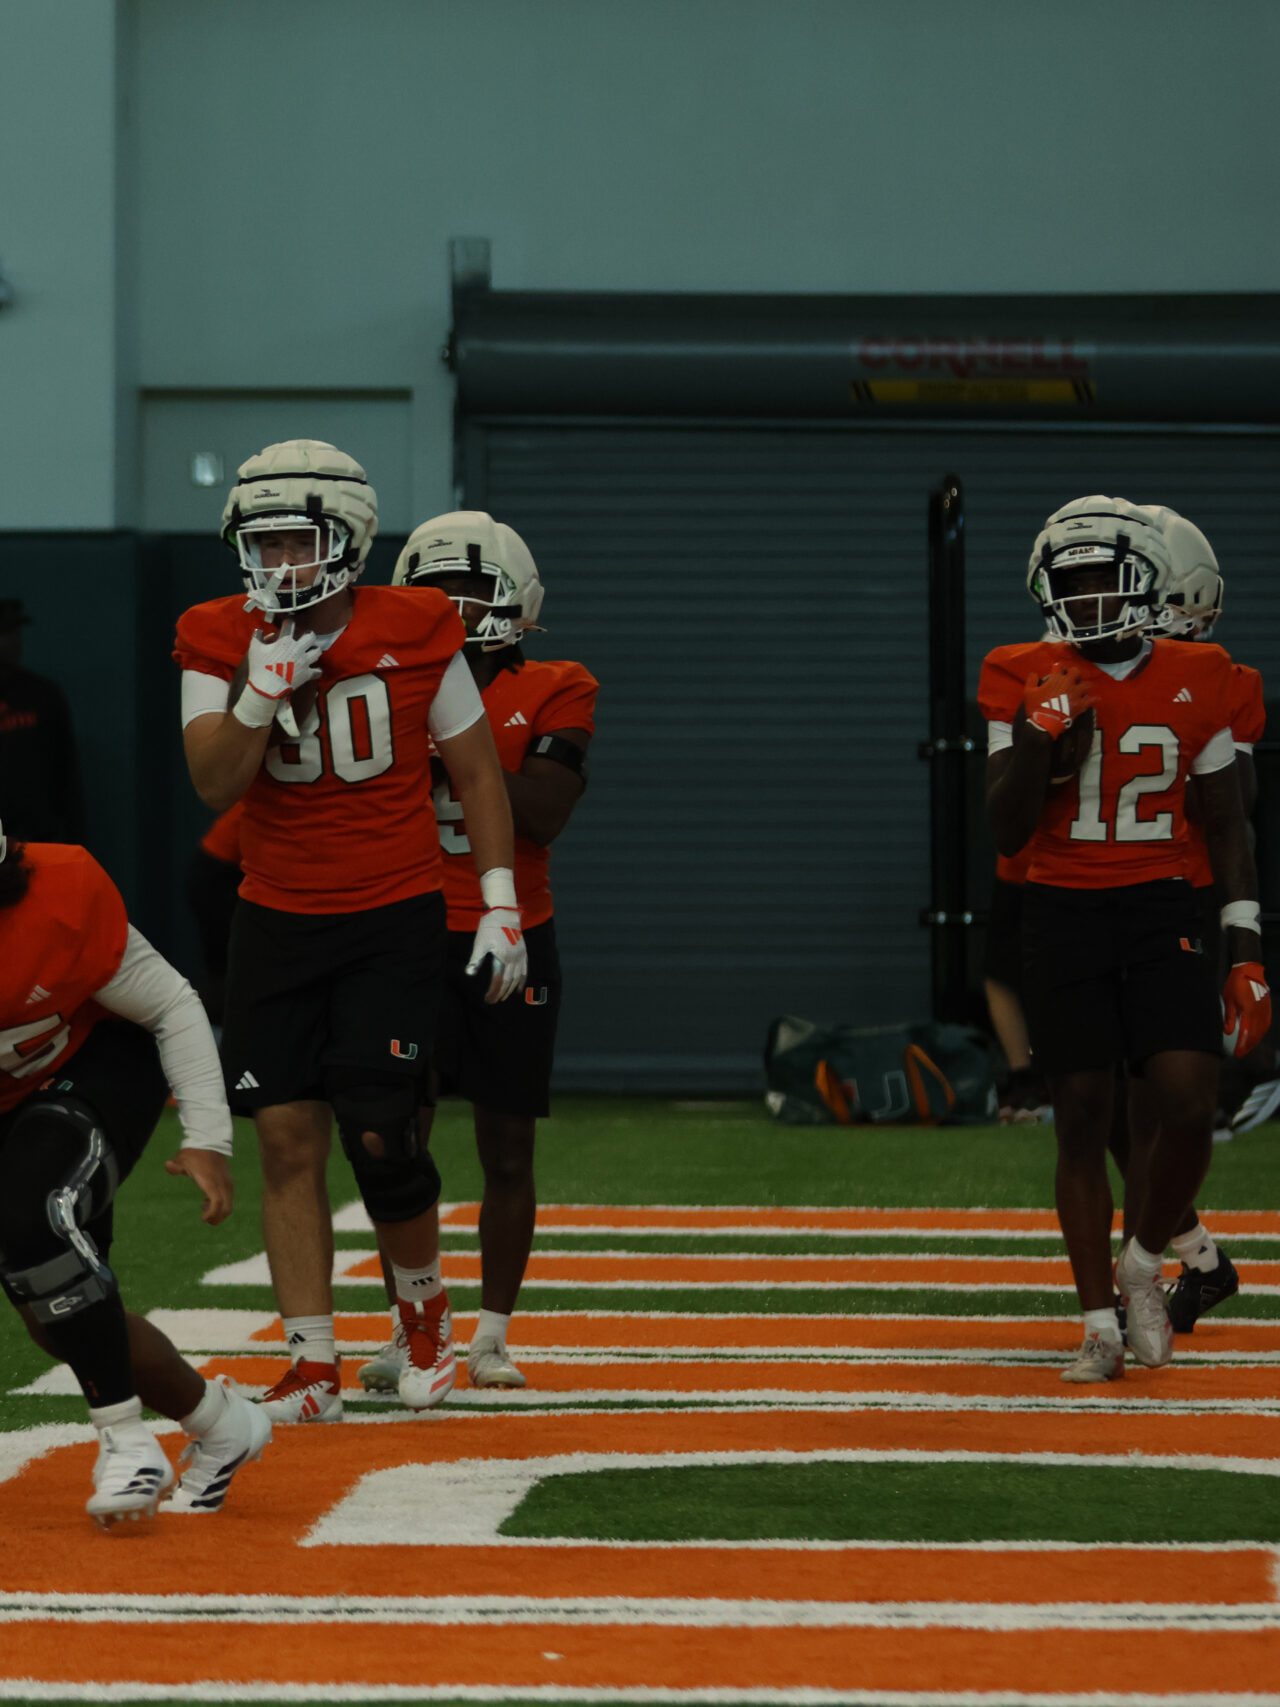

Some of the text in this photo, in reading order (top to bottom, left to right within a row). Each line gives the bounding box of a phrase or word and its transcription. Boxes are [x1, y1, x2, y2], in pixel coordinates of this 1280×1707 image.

[265, 672, 395, 784] 80
[1069, 725, 1180, 842] 12
[524, 986, 548, 1006] U
[390, 1038, 419, 1060] U
